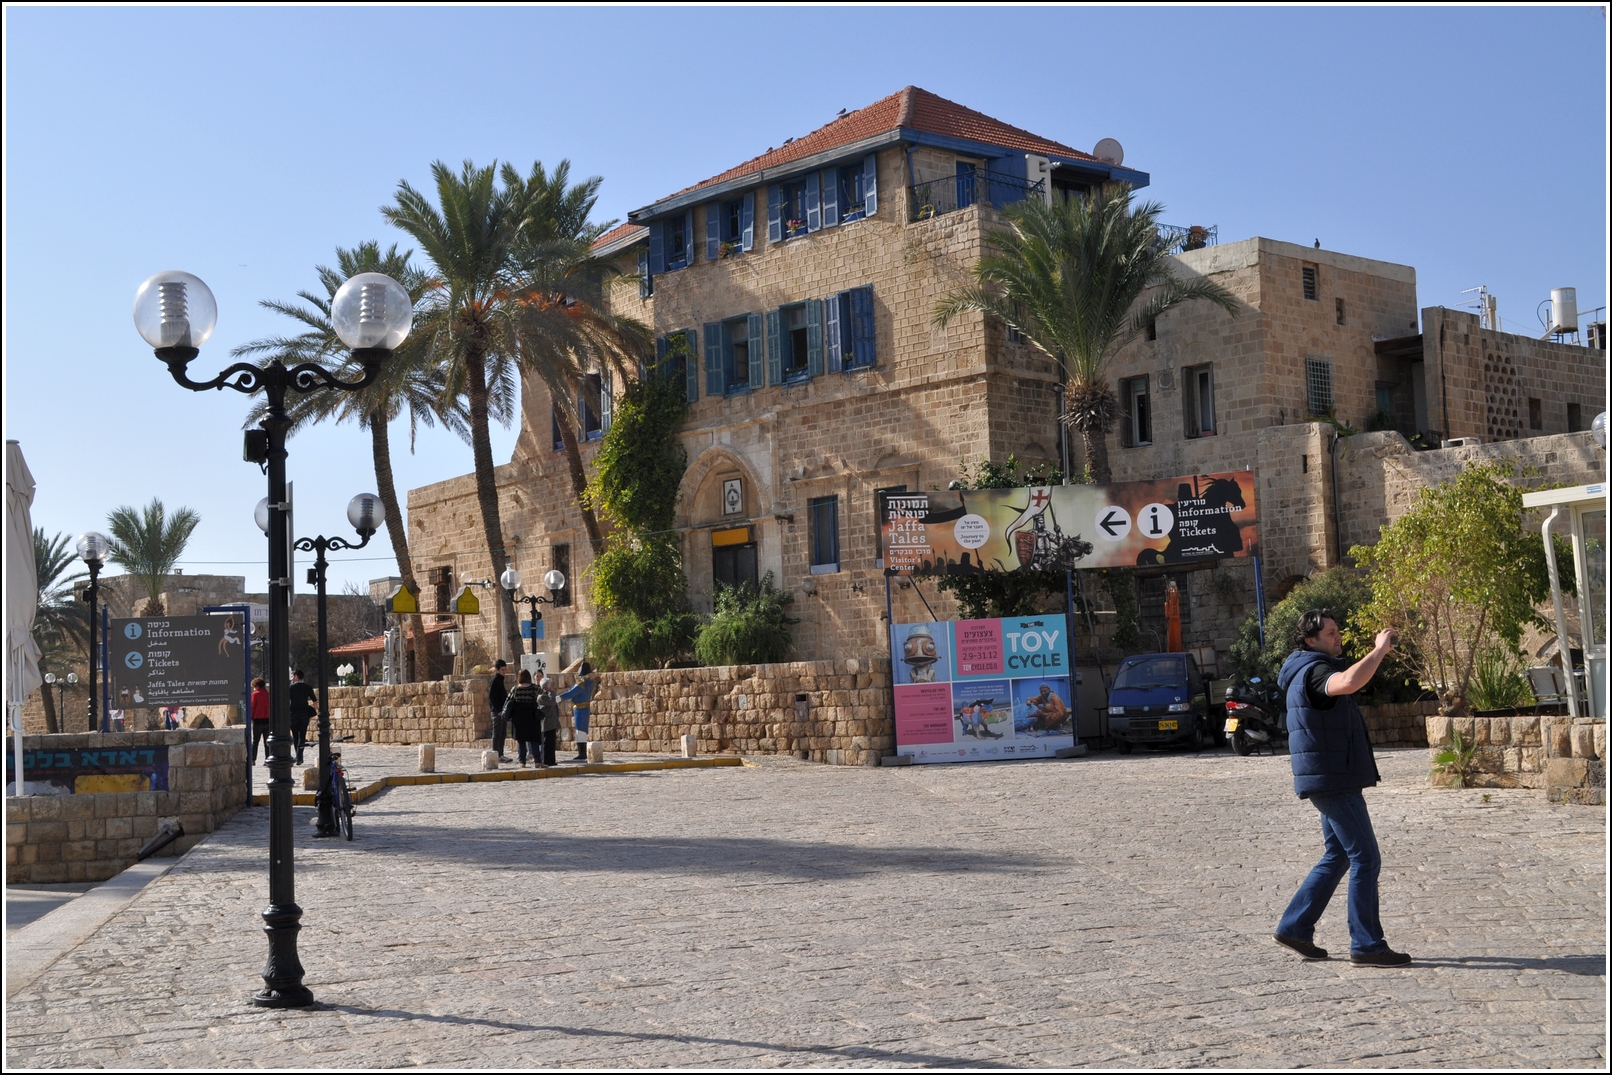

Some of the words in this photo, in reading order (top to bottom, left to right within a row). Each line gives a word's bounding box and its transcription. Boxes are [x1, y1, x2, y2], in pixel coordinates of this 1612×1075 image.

[888, 500, 928, 509] תמונות
[1178, 498, 1206, 508] מודיעין
[888, 510, 929, 520] יפואיות
[1178, 504, 1242, 518] information
[888, 520, 925, 532] Jaffa
[1179, 520, 1198, 528] קופה
[1179, 527, 1217, 538] Tickets
[888, 532, 926, 544] Tales
[147, 628, 211, 638] Information
[964, 630, 993, 638] צעצועים
[1006, 630, 1059, 652] TOY
[963, 651, 998, 660] 2.9-31.12
[148, 658, 179, 667] Tickets
[1008, 653, 1061, 669] CYCLE
[963, 663, 998, 671] TOYCYCLE.CO.IL
[148, 669, 165, 677] تذاكر
[81, 750, 156, 766] דאדא
